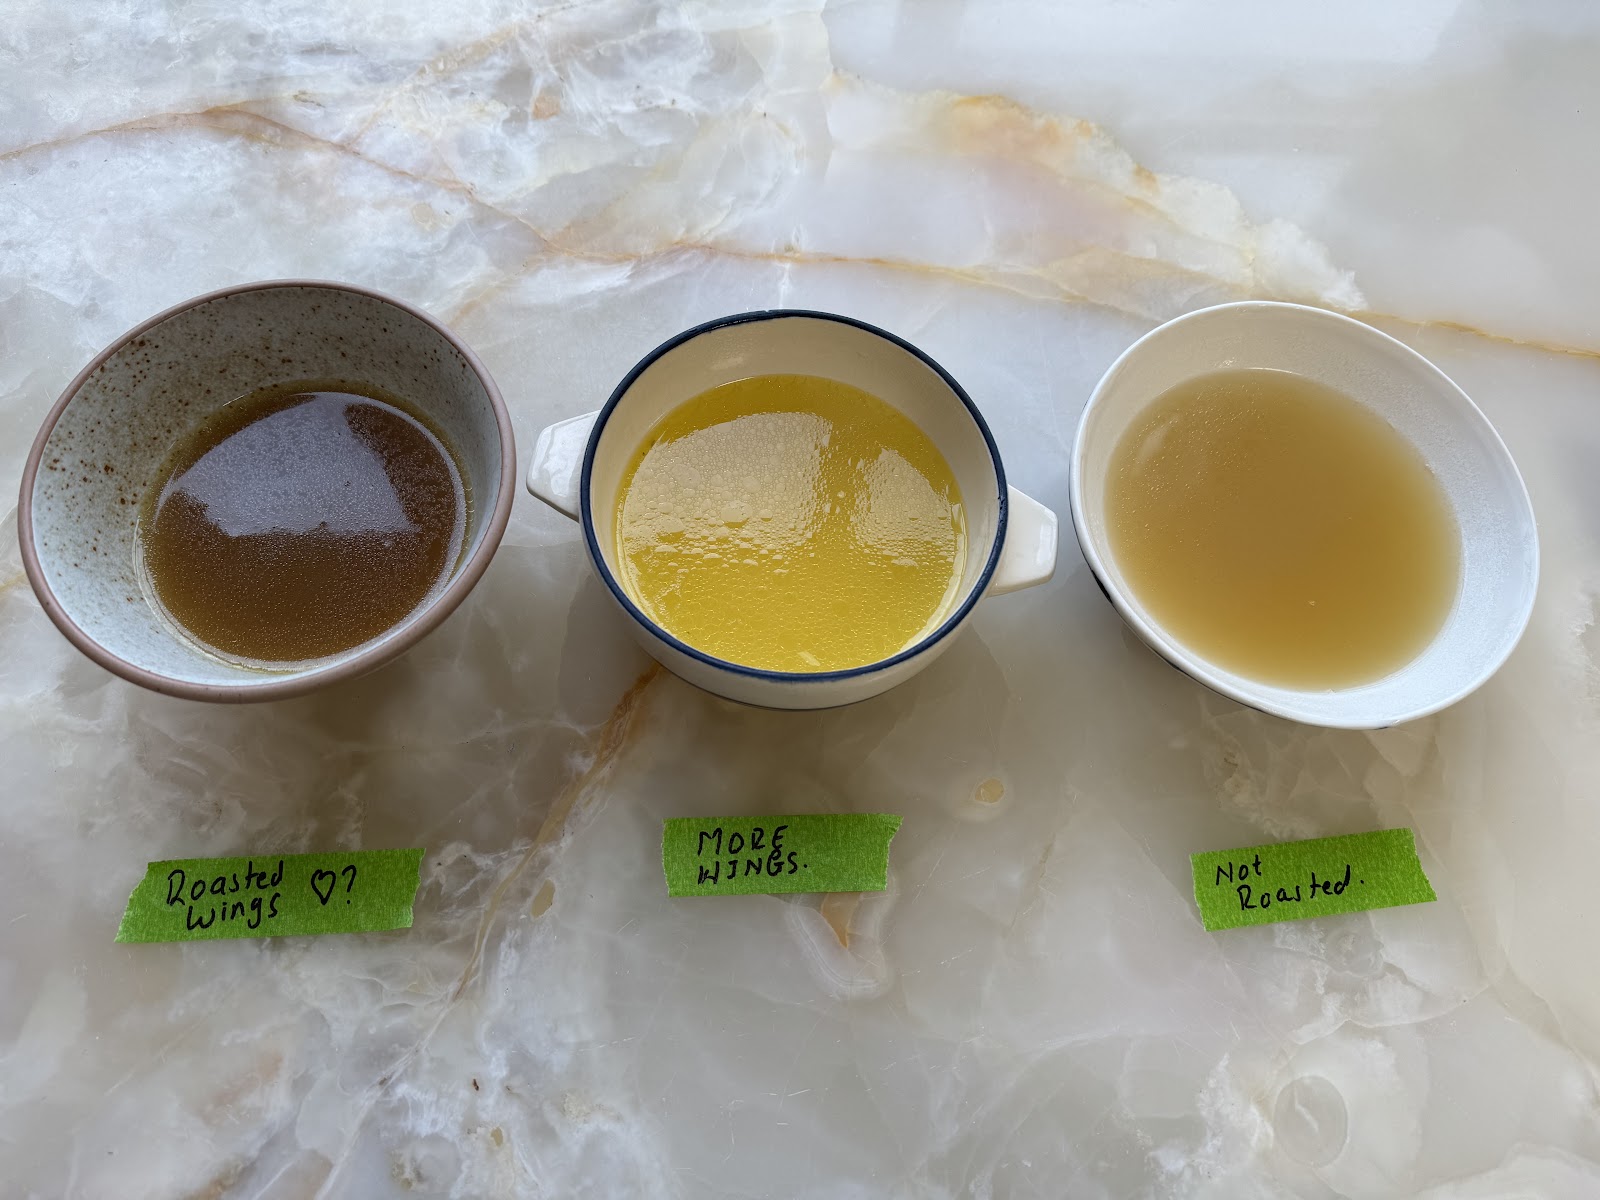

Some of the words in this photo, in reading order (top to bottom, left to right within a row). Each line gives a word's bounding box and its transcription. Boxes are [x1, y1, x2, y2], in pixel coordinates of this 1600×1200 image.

[698, 825, 788, 856] MORE
[166, 860, 284, 907] Roasted
[698, 850, 808, 885] WINGS.
[1216, 854, 1262, 886] Not
[1237, 864, 1365, 911] Roasted.
